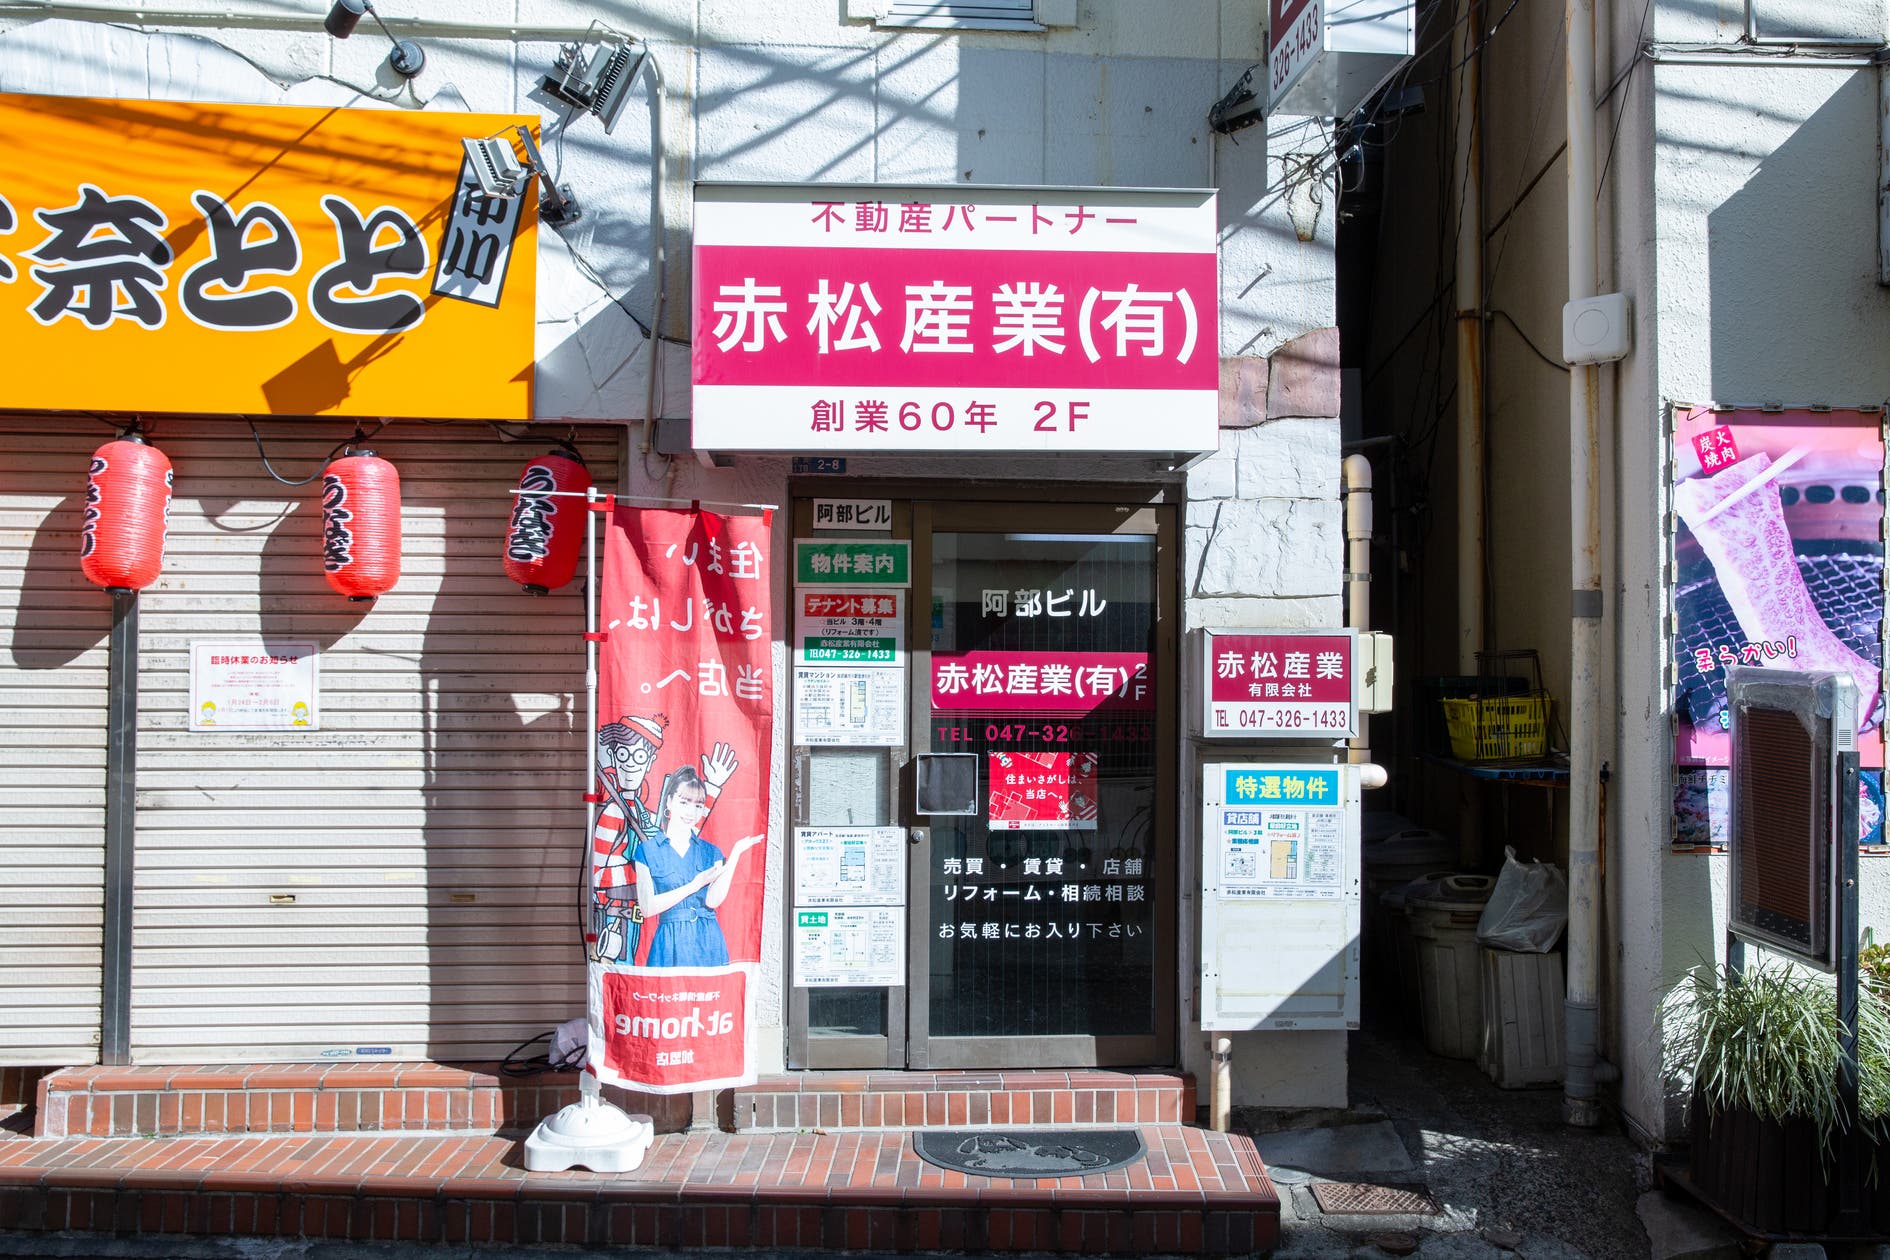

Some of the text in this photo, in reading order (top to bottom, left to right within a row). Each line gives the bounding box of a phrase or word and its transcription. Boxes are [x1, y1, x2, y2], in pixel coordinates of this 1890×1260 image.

[1273, 3, 1319, 91] 326-1433
[811, 199, 1139, 235] 不動産パートナー
[0, 183, 427, 334] 奈とと
[711, 276, 1200, 366] 赤松産業(有)
[810, 399, 1092, 434] 創業60年 2F
[1698, 430, 1732, 453] 炭火
[817, 459, 840, 470] 2-8
[1703, 446, 1737, 470] 焼肉
[817, 504, 890, 524] 阿部ビル
[811, 553, 894, 573] 物件案内
[808, 598, 893, 614] テナント募集
[981, 588, 1107, 619] 阿部ビル
[826, 617, 847, 626] 当ビル
[210, 655, 298, 665] 臨時休業のお知らせ
[1217, 650, 1344, 680] 赤松産業
[798, 671, 836, 679] 賃貸マンション
[936, 662, 1129, 698] 赤松産業(有)
[1248, 682, 1313, 697] 有限会社
[1239, 709, 1346, 728] 047-326-1433
[938, 724, 1151, 743] TEL 047-326-1433
[1235, 775, 1329, 799] 特選物件
[944, 884, 1145, 902] リフォーム・相続相談
[938, 922, 1144, 940] お気軽にお入り下さい
